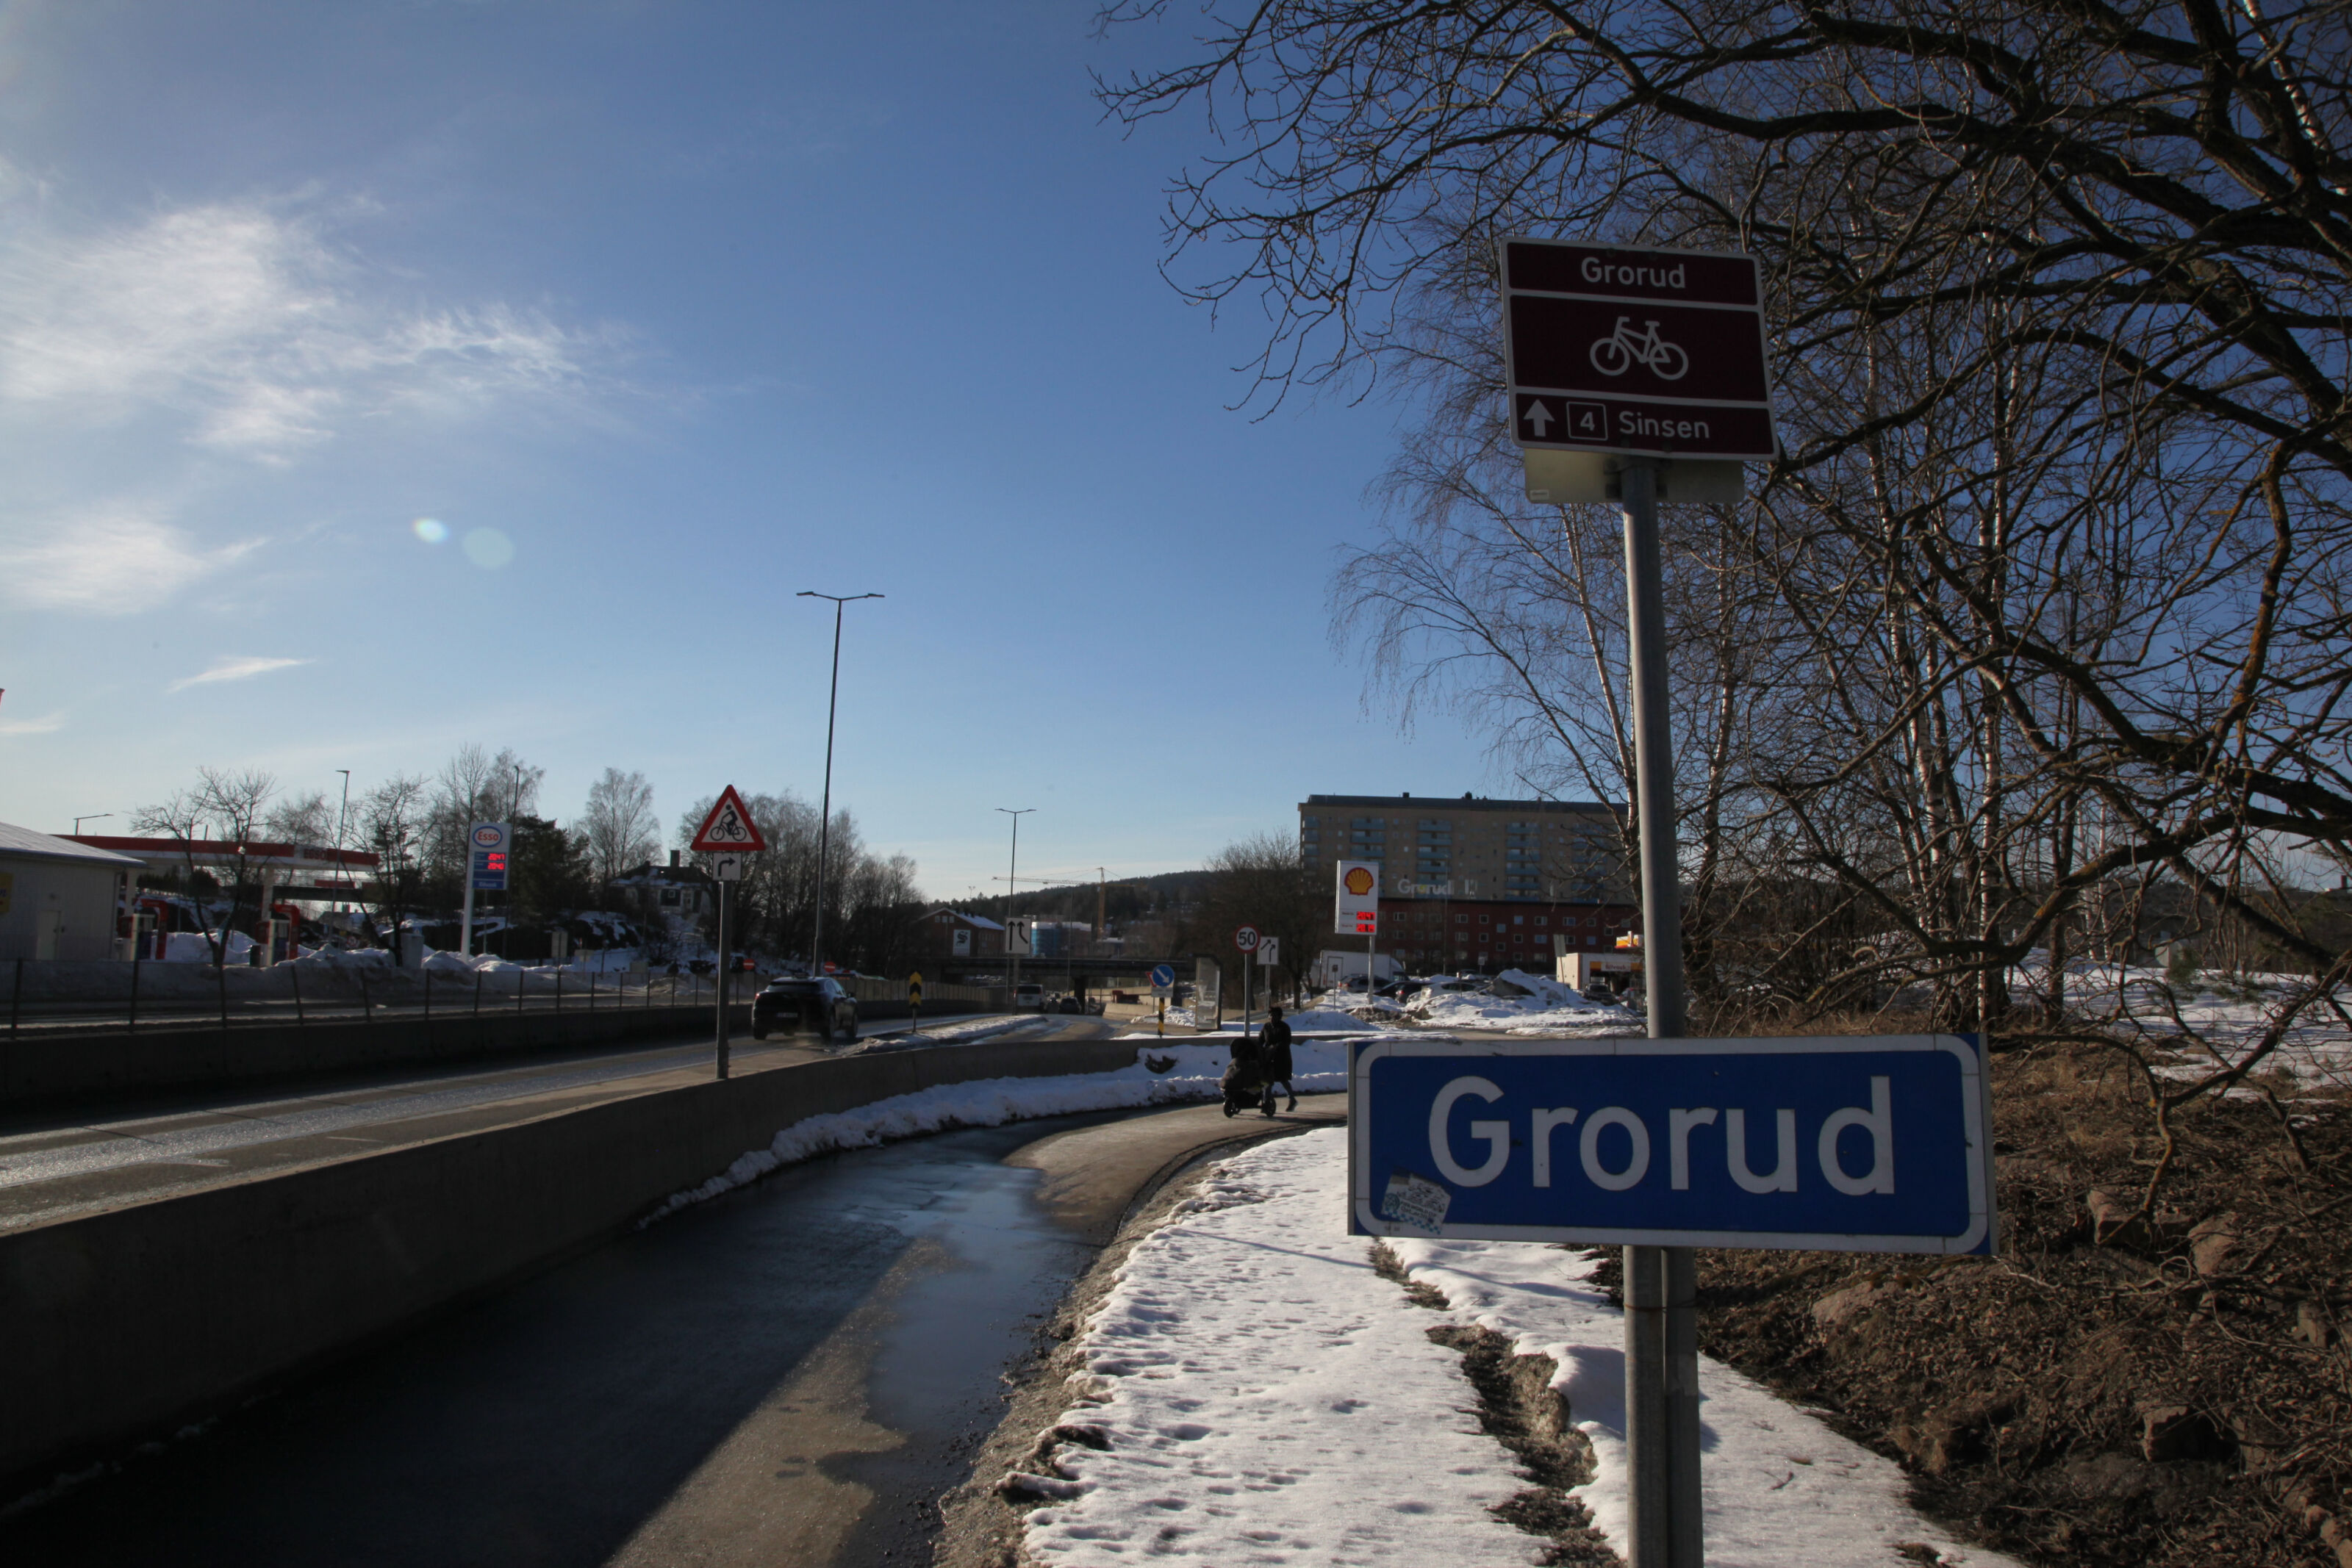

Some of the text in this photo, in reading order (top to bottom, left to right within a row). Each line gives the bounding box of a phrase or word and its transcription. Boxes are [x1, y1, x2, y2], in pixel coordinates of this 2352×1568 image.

[1581, 256, 1686, 289] Grorud
[1580, 411, 1710, 439] 4 Sinsen
[478, 831, 499, 841] Esso
[1238, 931, 1256, 946] 50
[1428, 1075, 1895, 1195] Grorud
